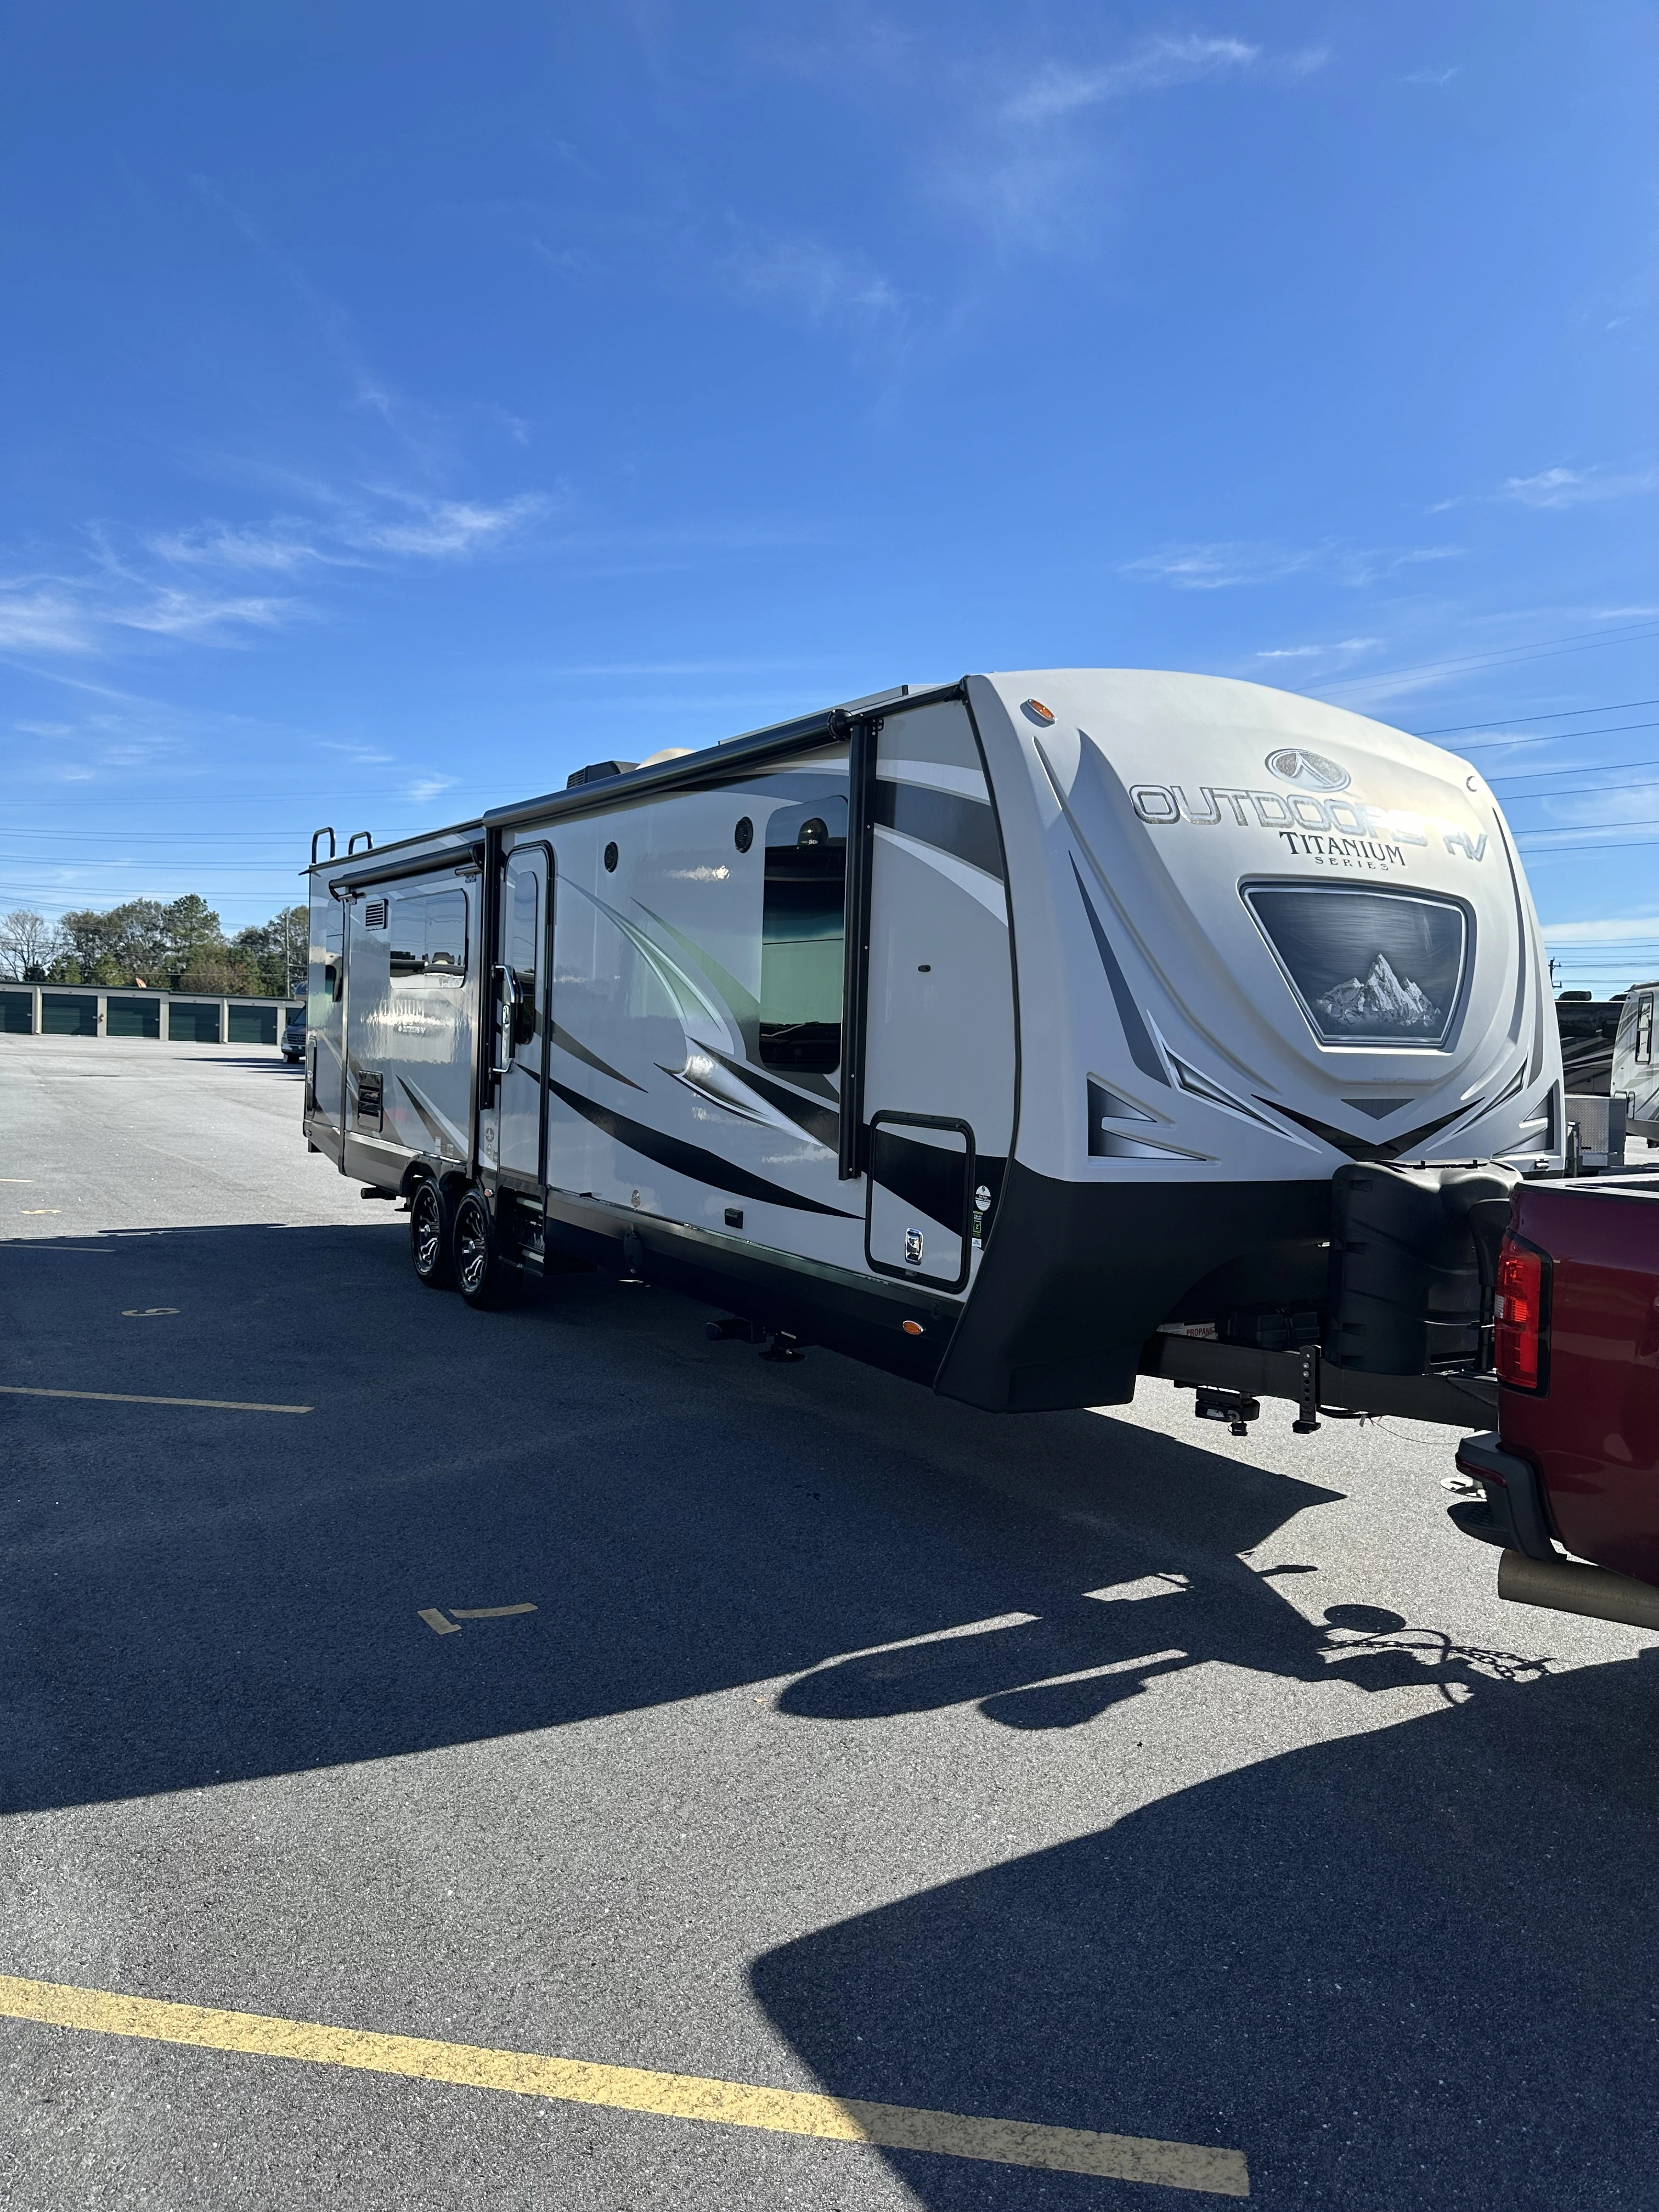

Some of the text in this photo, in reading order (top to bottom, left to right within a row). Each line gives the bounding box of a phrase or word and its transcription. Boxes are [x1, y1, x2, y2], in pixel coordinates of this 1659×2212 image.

[1129, 785, 1428, 847] OUTDOORS
[1279, 831, 1407, 866] TITANIUM
[1314, 856, 1389, 871] SERIES
